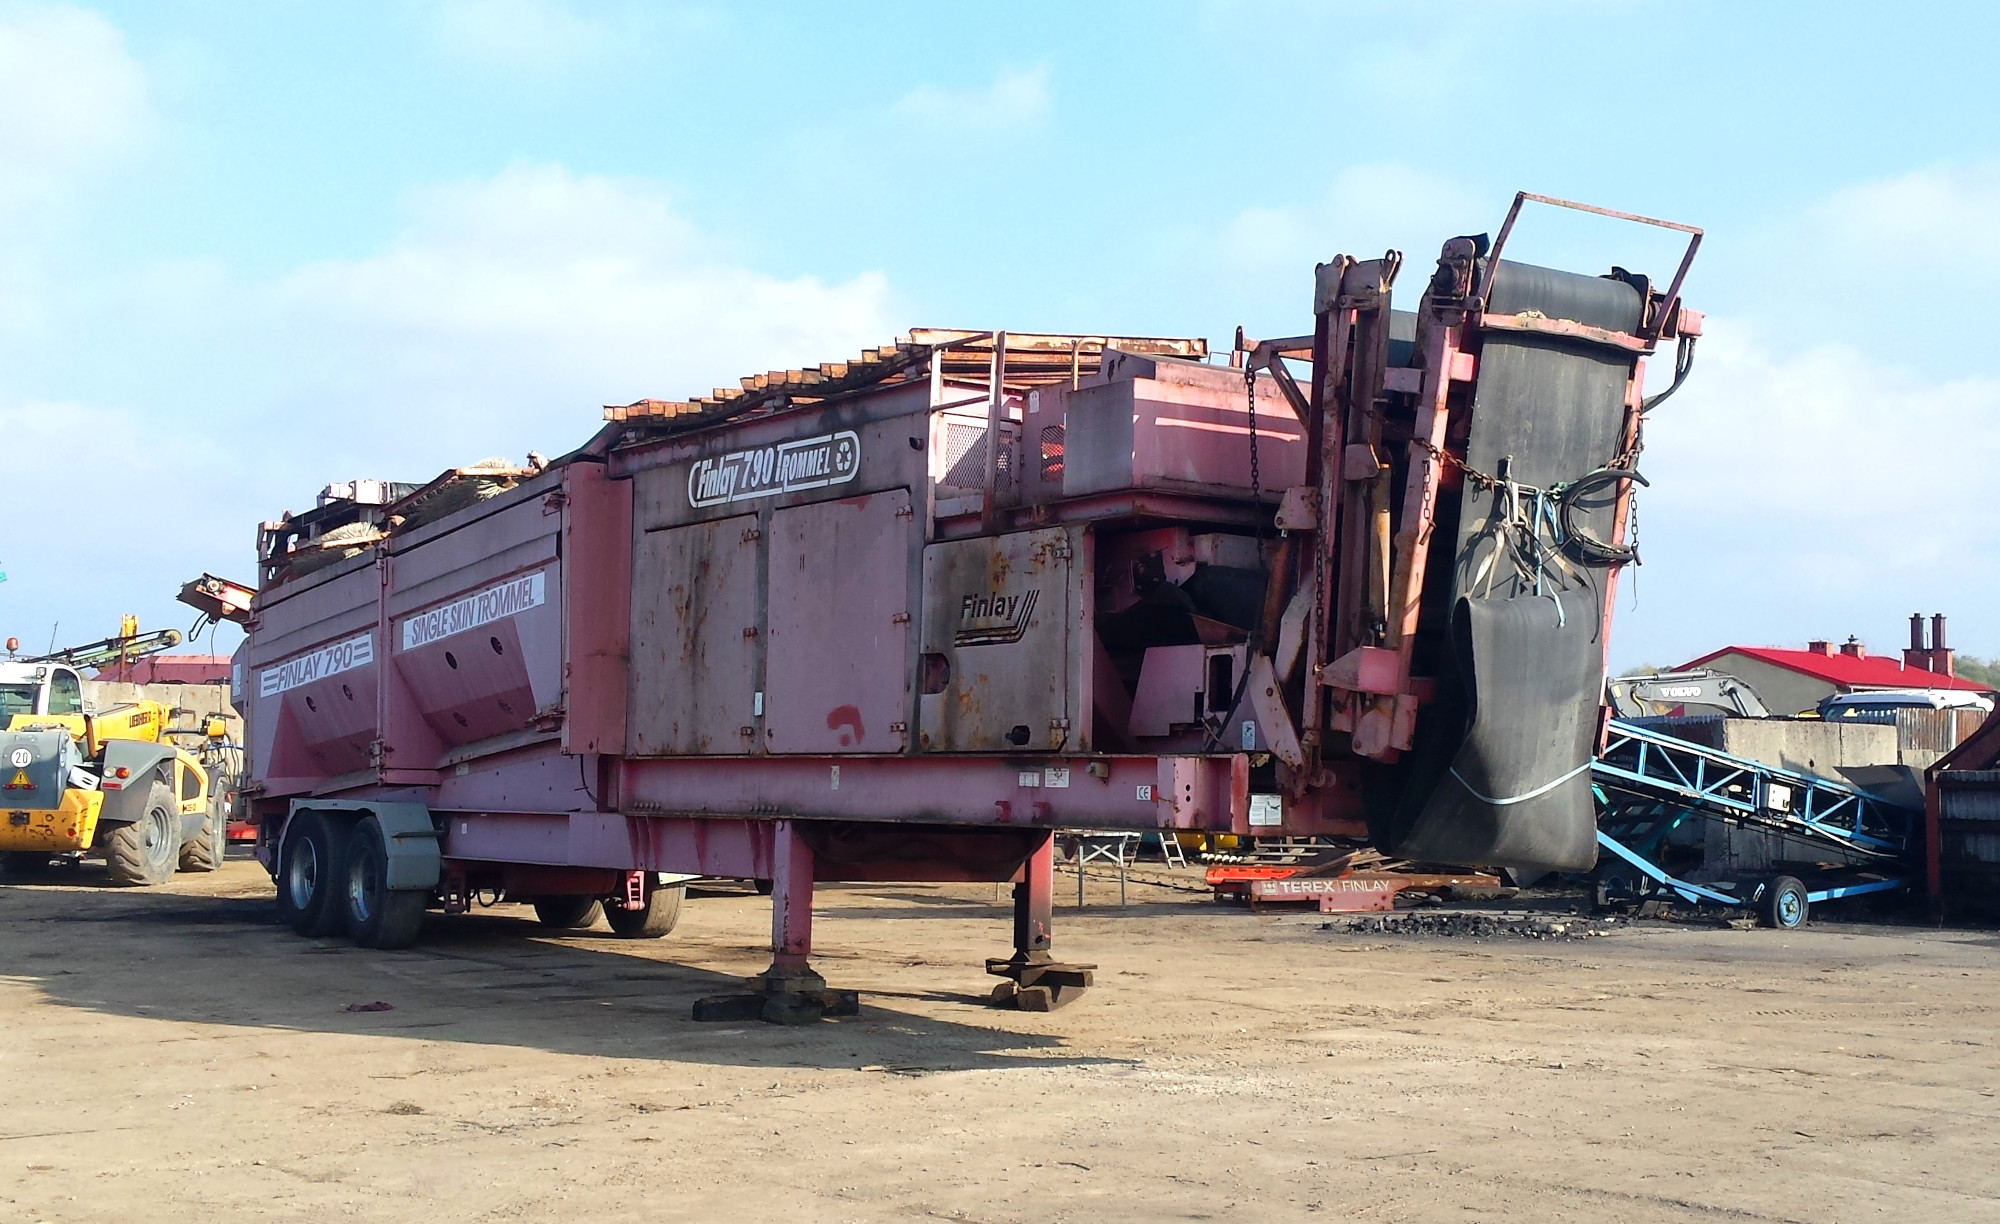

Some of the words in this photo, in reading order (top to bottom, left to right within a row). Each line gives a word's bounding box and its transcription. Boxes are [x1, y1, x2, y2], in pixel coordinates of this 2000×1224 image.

[697, 456, 740, 503] Finlay
[741, 447, 775, 489] 790
[412, 608, 449, 646] SINGLE
[450, 599, 476, 633] SKIN
[478, 578, 534, 624] TROMMEL
[961, 591, 1019, 621] Finlay
[277, 653, 322, 692] FINLAY
[325, 643, 353, 676] 790
[1660, 686, 1702, 698] VOLVO
[15, 751, 29, 764] 20
[1280, 881, 1335, 893] TEREX
[1342, 880, 1390, 892] FINLAY
